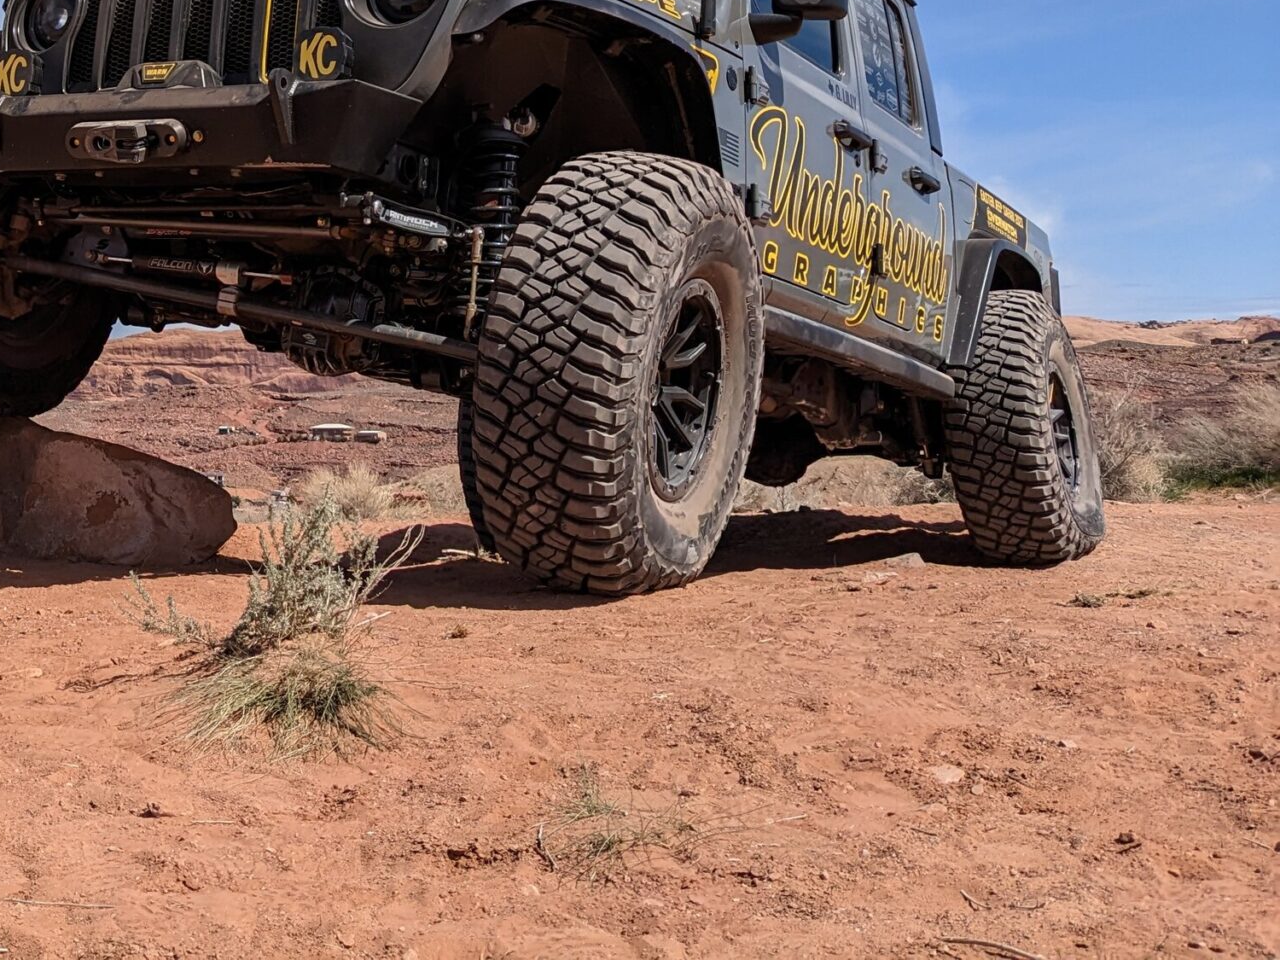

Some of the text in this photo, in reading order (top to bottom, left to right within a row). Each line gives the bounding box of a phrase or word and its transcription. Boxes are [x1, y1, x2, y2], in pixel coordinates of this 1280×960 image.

[299, 32, 338, 79] KC
[750, 105, 947, 327] Underground
[150, 257, 193, 271] FALCON
[763, 242, 944, 342] GRAPHICS
